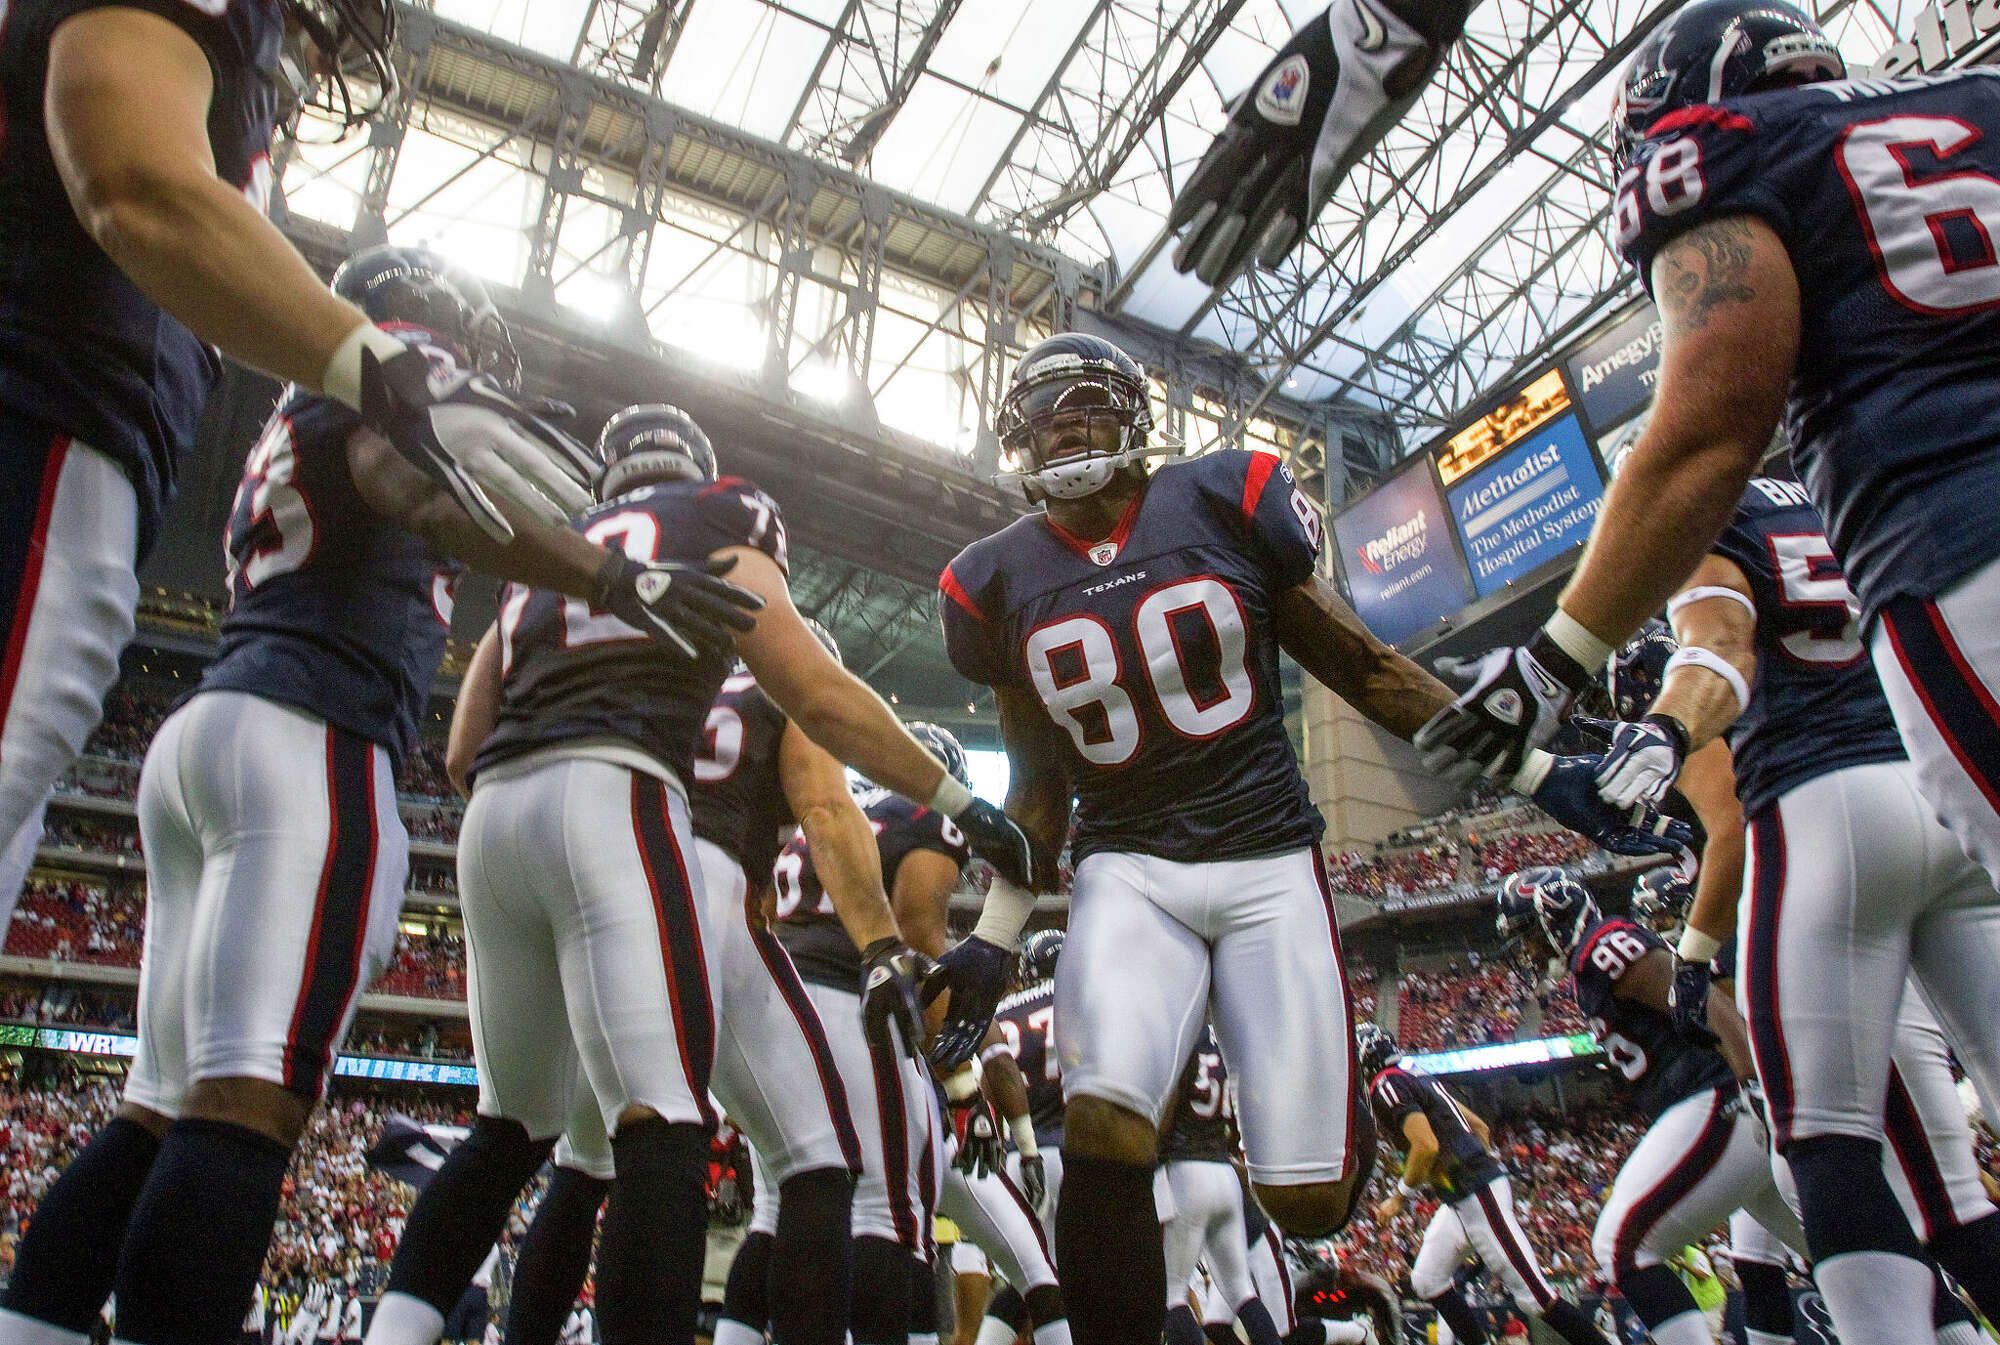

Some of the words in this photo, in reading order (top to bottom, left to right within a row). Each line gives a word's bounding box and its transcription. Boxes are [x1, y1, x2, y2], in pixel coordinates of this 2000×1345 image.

[1613, 137, 1703, 247] 68
[1462, 443, 1561, 520] Methodist
[1366, 509, 1427, 563] Reliant
[1470, 532, 1502, 557] The
[1501, 484, 1580, 540] Methodist
[1082, 571, 1146, 596] TEXANS
[1476, 529, 1542, 577] Hospital
[1025, 576, 1255, 767] 80
[1591, 930, 1646, 979] 96
